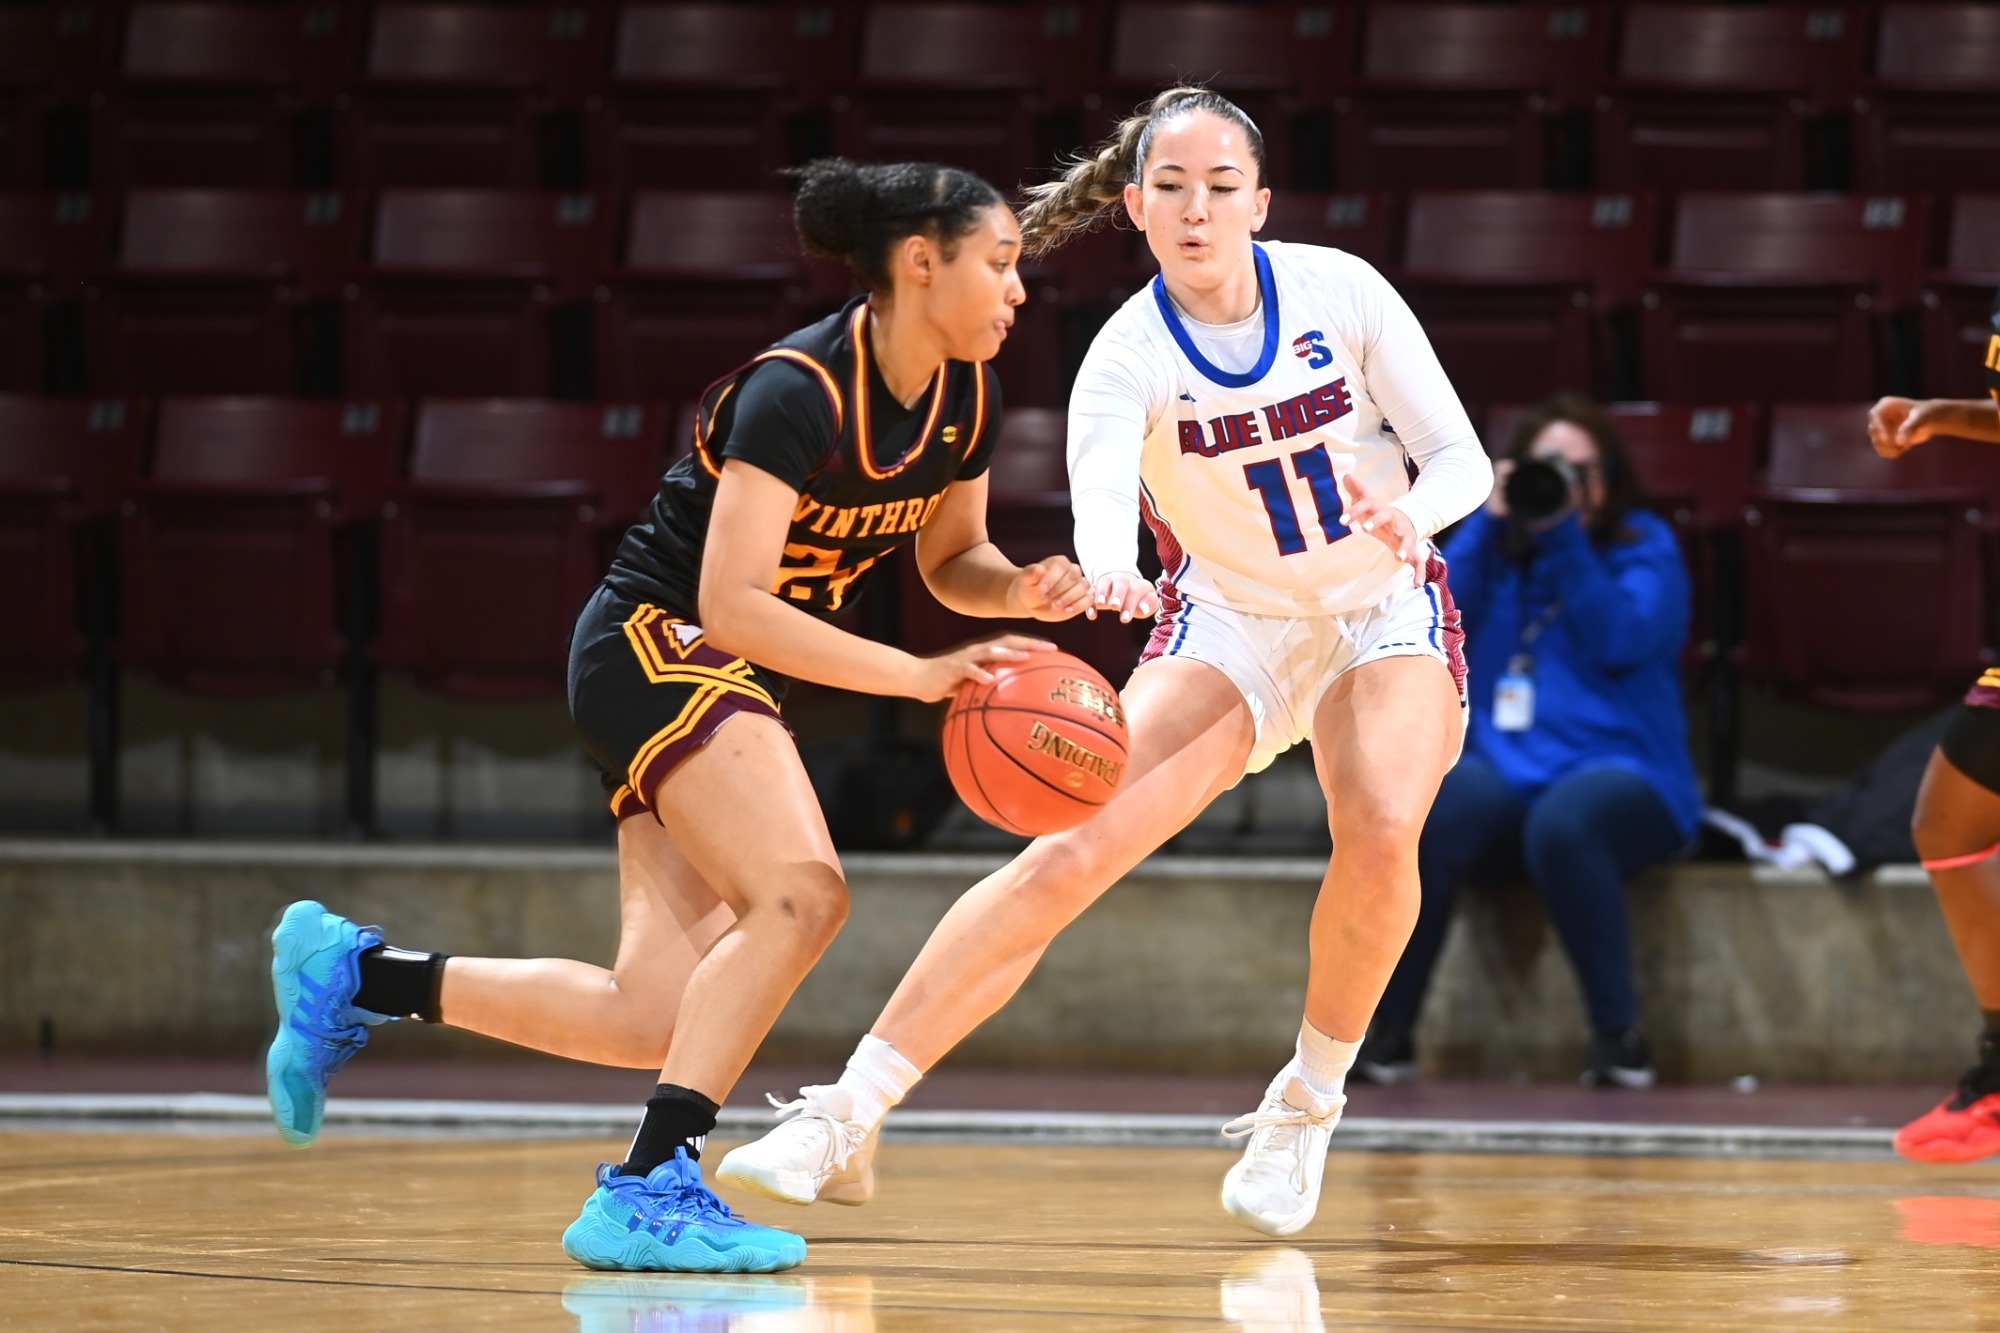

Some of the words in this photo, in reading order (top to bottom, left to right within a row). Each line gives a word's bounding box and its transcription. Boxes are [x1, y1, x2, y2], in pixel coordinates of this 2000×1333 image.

[1178, 411, 1262, 458] BLUE
[1260, 376, 1354, 441] HOSE
[792, 486, 948, 538] INTHRO
[1242, 442, 1352, 556] 11
